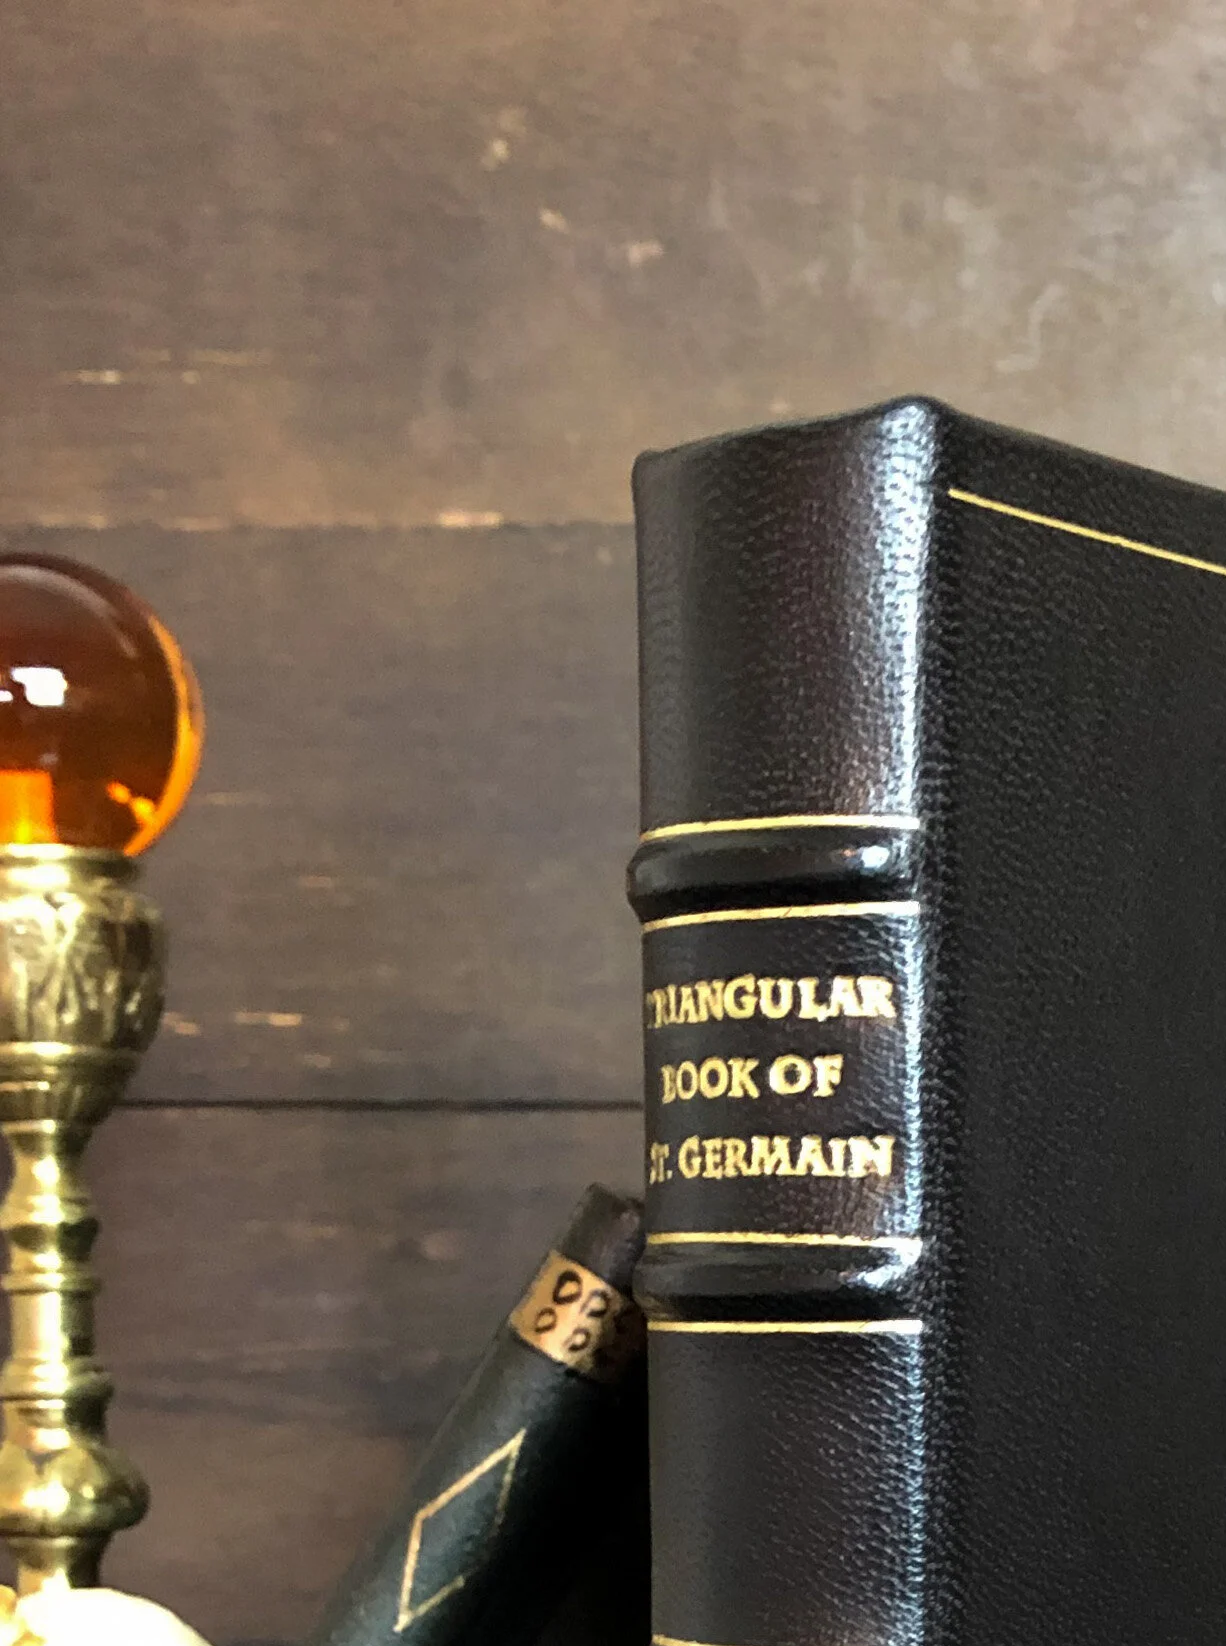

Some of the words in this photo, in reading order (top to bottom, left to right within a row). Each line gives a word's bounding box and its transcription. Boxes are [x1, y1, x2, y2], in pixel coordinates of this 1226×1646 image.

[660, 1056, 760, 1104] BOOK
[769, 1053, 843, 1098] OF
[677, 1134, 896, 1179] GERMAIN
